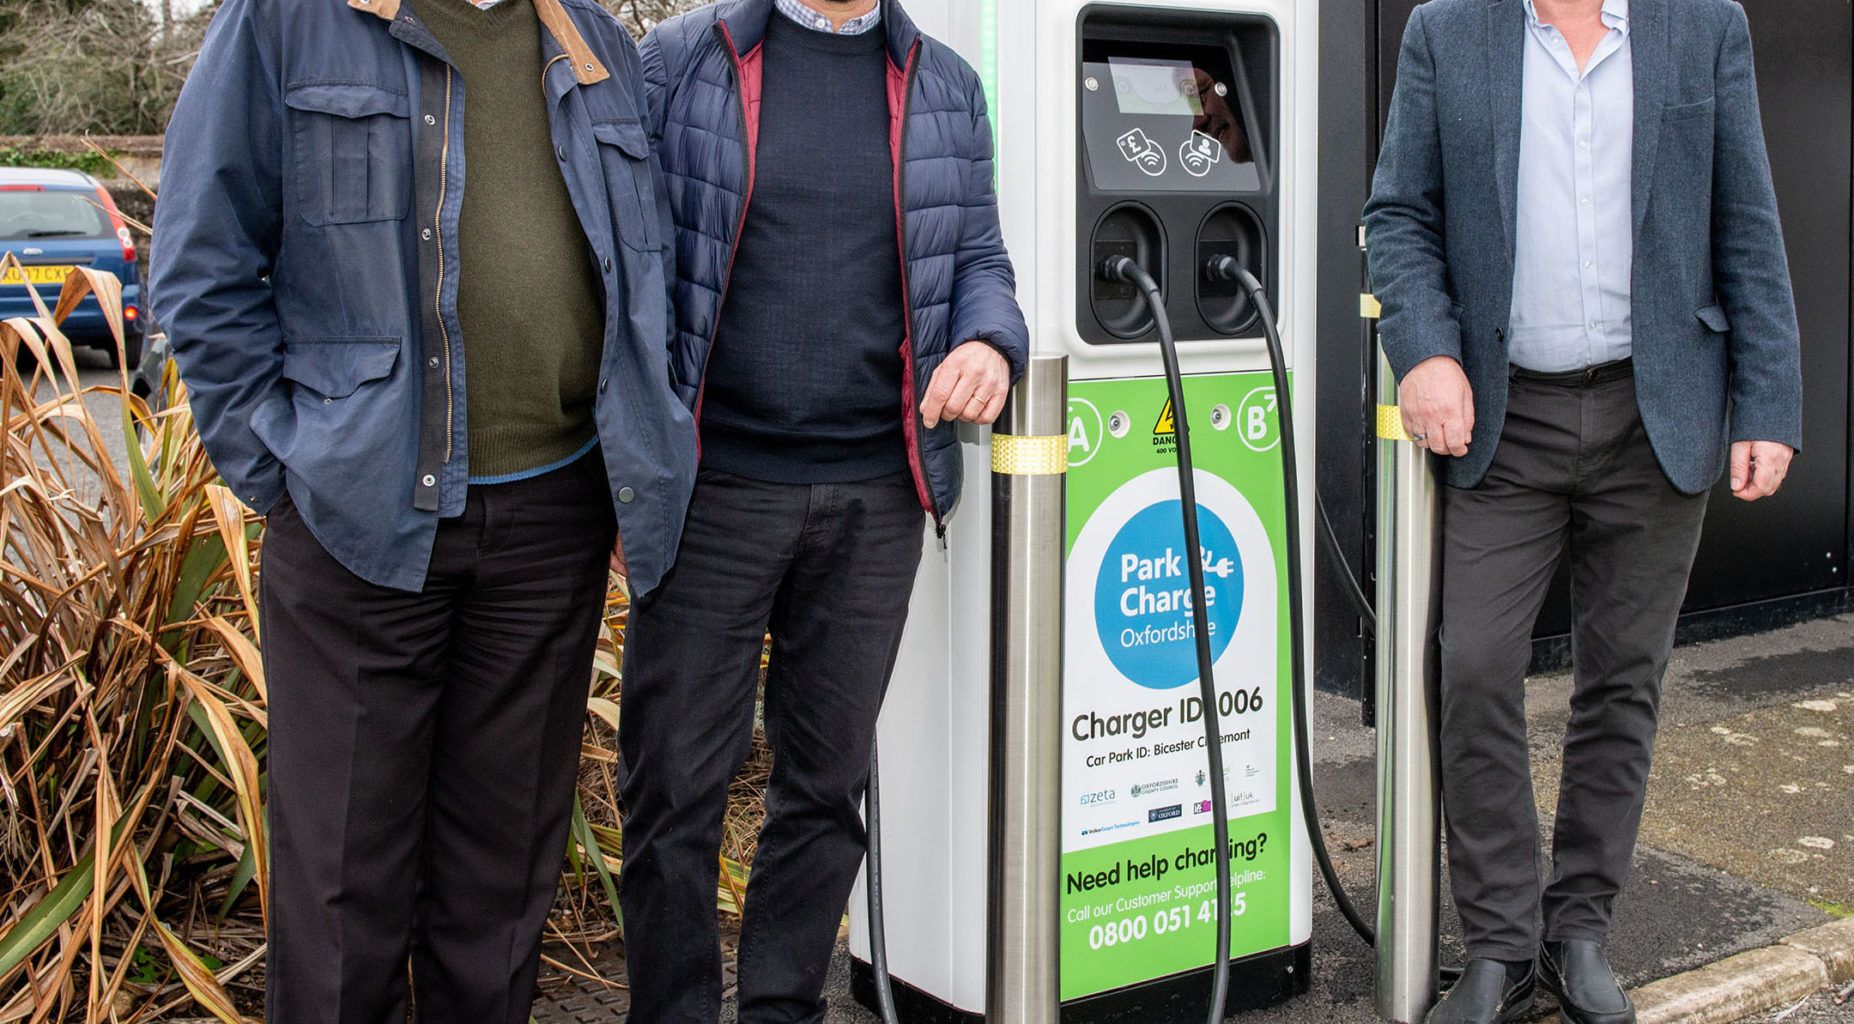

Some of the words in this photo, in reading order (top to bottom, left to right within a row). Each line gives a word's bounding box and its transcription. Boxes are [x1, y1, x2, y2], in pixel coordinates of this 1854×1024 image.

[1068, 416, 1090, 452] A
[1248, 406, 1267, 440] B
[1121, 547, 1182, 583] Park
[1120, 620, 1216, 648] Oxfordshe
[1072, 706, 1172, 741] Charger
[1218, 686, 1263, 717] 006
[1086, 755, 1106, 767] Car
[1109, 748, 1133, 764] Park
[1136, 745, 1151, 759] ID:
[1154, 740, 1195, 756] Bicester
[1090, 787, 1116, 803] zeta
[1158, 809, 1181, 819] OXFORD
[1067, 862, 1120, 895] Need
[1127, 854, 1169, 881] help
[1174, 832, 1267, 871] charing?
[1067, 903, 1090, 924] Call
[1093, 903, 1113, 918] our
[1115, 889, 1172, 913] Customer
[1089, 914, 1148, 950] 0800
[1154, 904, 1190, 935] 051
[1197, 892, 1247, 923] 415
